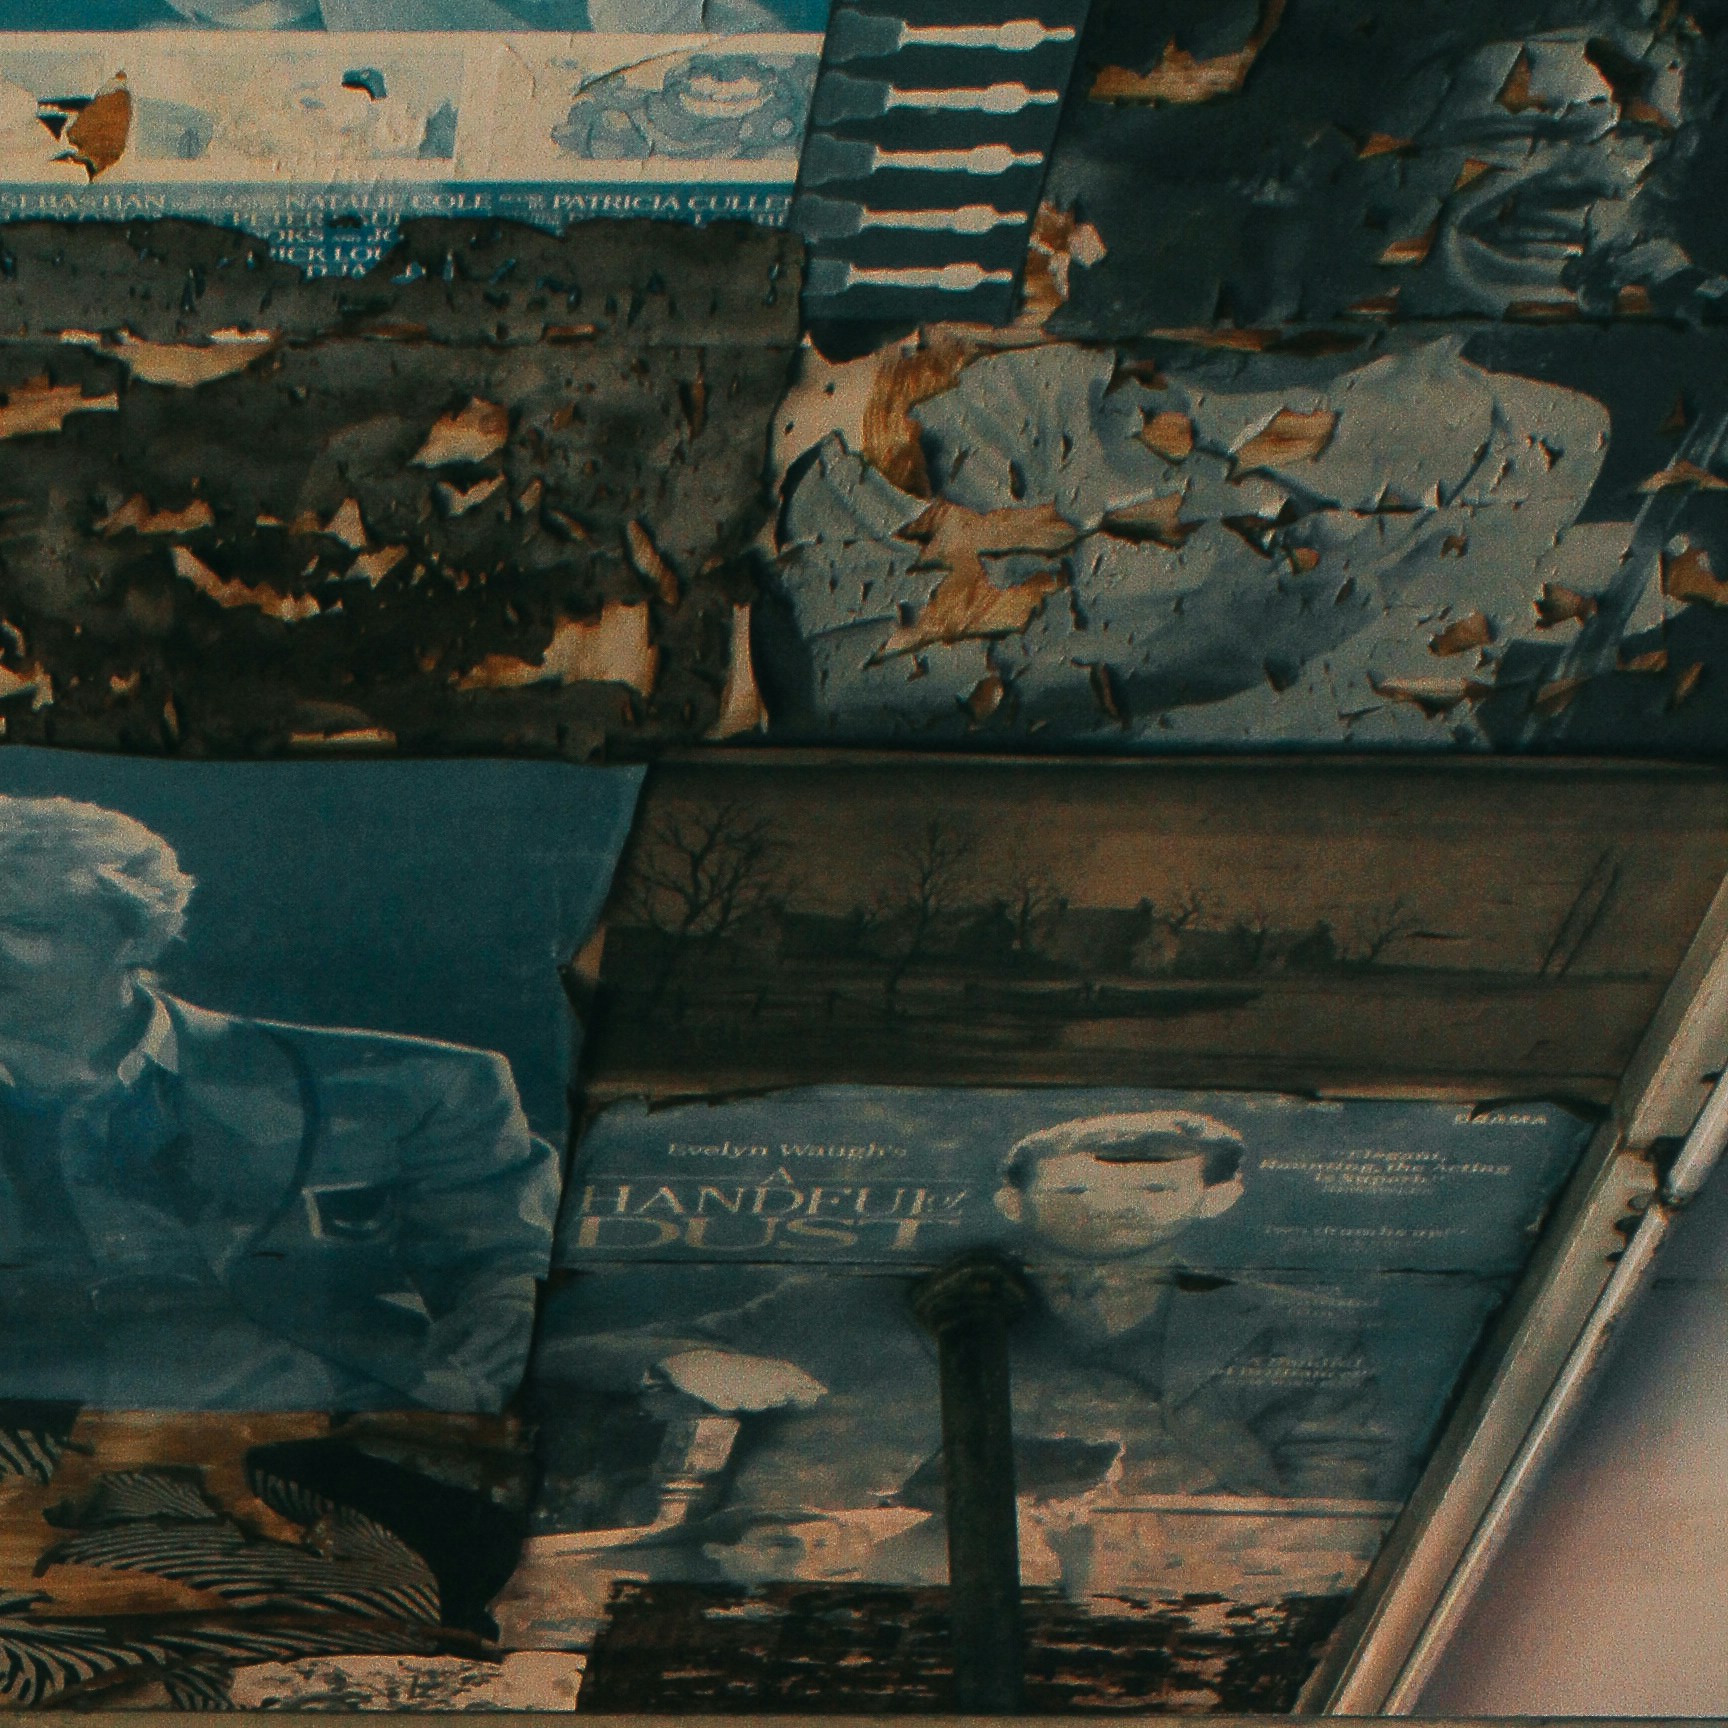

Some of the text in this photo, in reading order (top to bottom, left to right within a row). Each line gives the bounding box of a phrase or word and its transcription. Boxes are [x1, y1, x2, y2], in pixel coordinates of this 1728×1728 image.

[553, 194, 681, 210] PATRICIA
[668, 1141, 908, 1161] Evelyn Waugh's
[759, 1165, 796, 1188] A
[581, 1185, 932, 1215] HANDFUL
[576, 1214, 964, 1252] DUST
